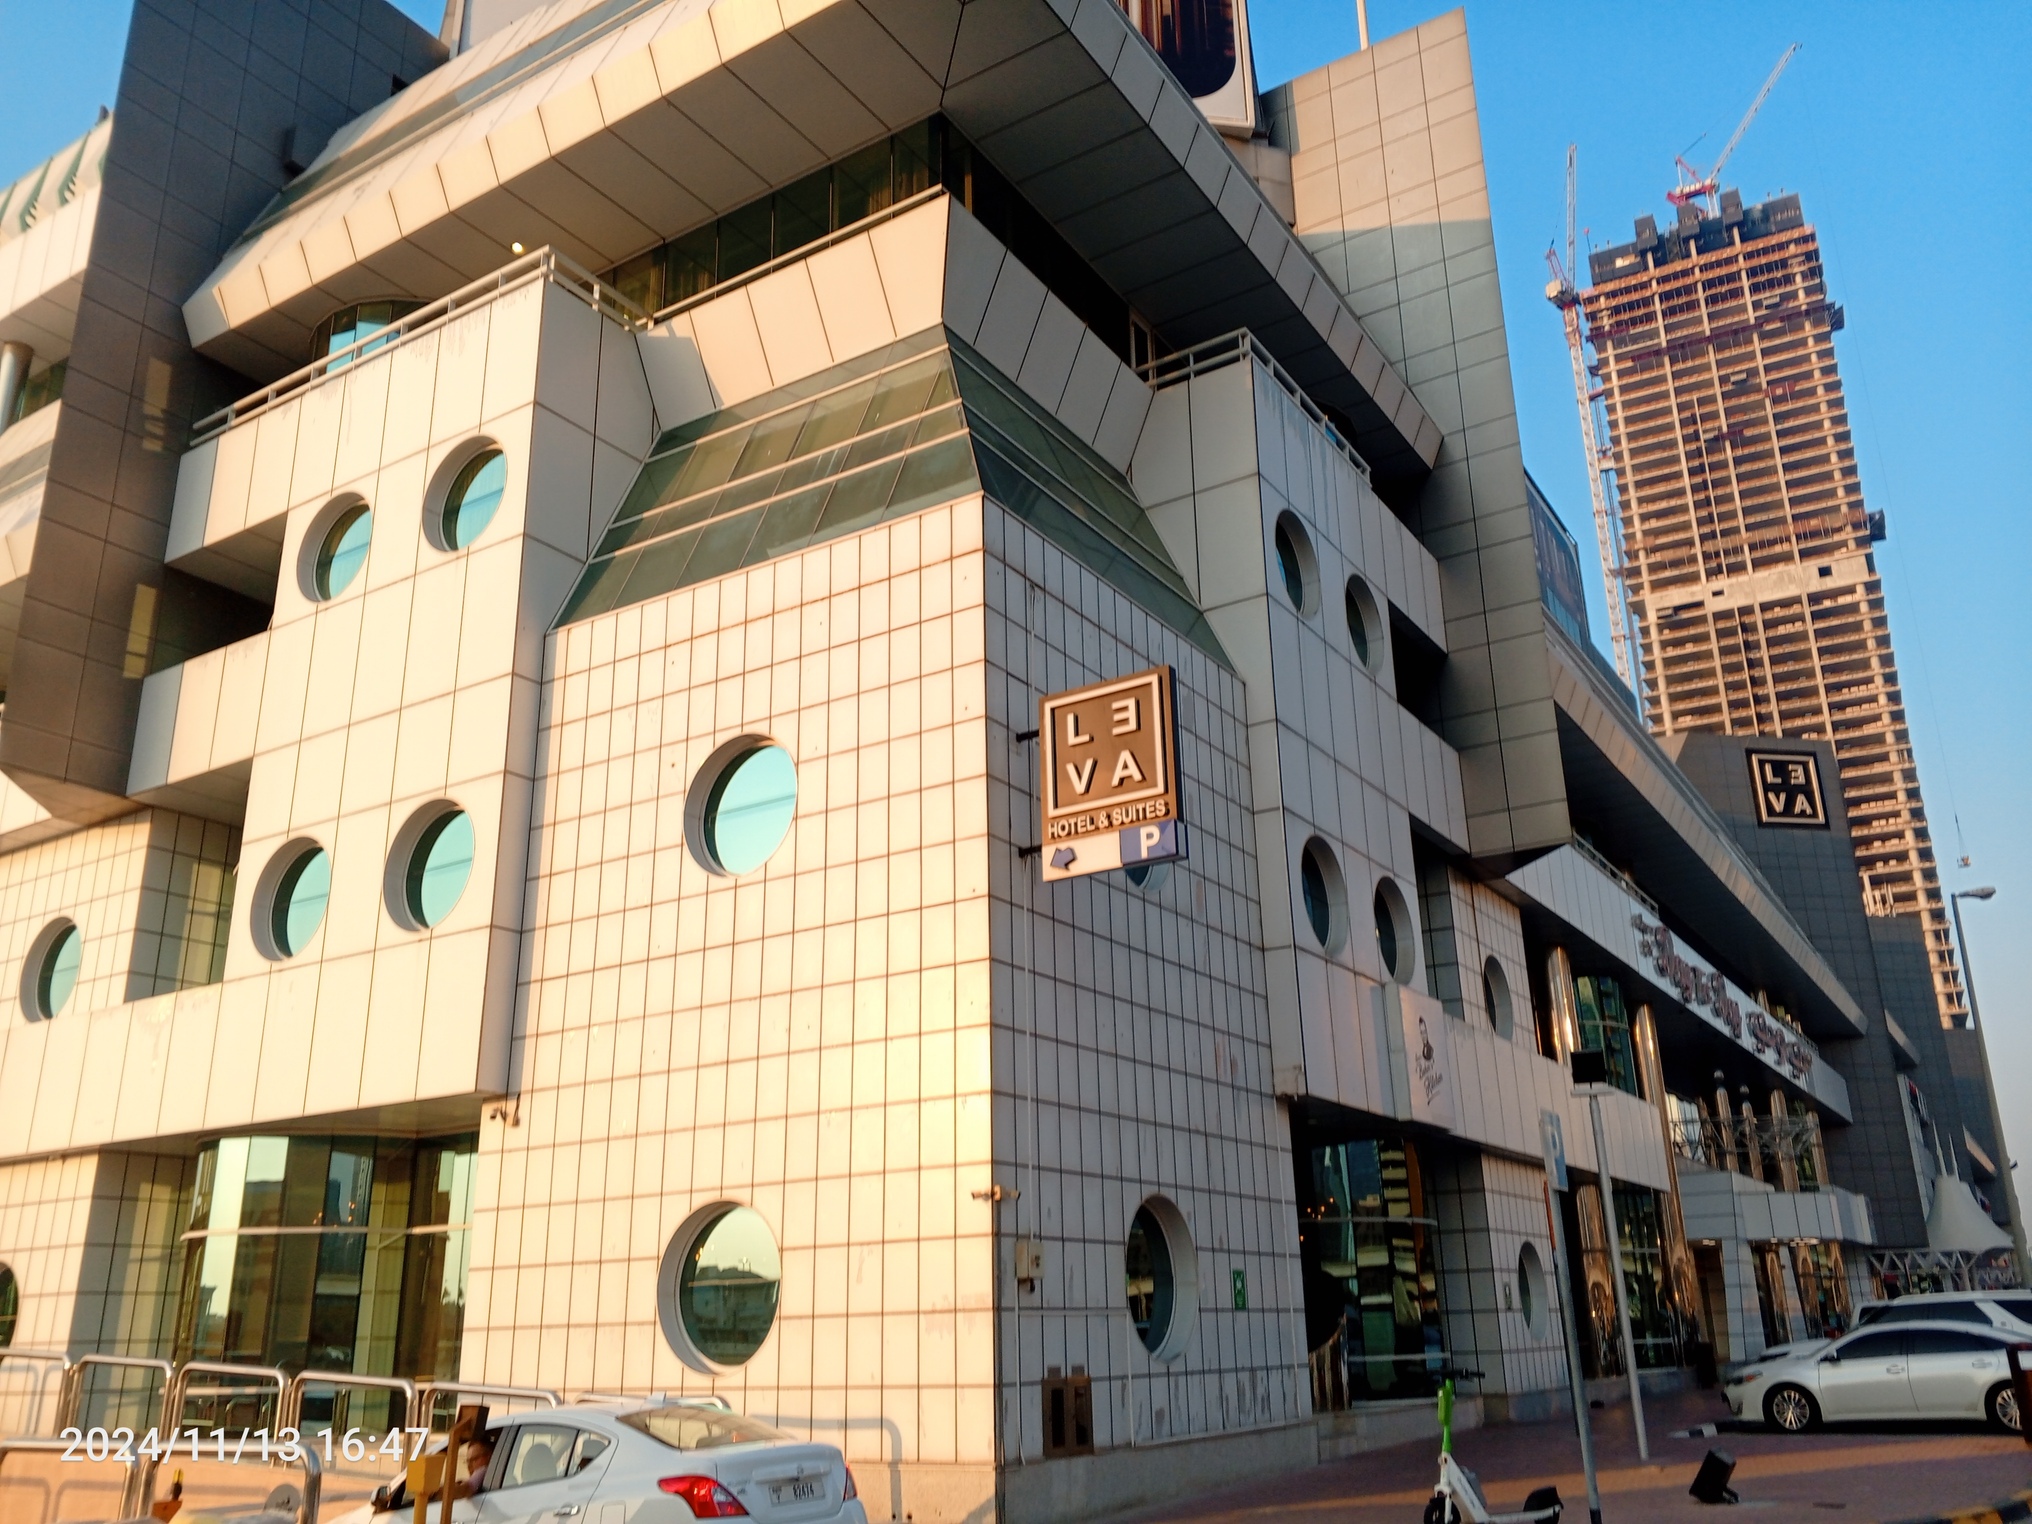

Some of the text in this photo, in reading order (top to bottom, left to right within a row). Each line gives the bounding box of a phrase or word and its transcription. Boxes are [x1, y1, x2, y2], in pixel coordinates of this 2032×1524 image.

[1048, 798, 1169, 839] HOTEL & SUITES
[1140, 824, 1161, 859] P
